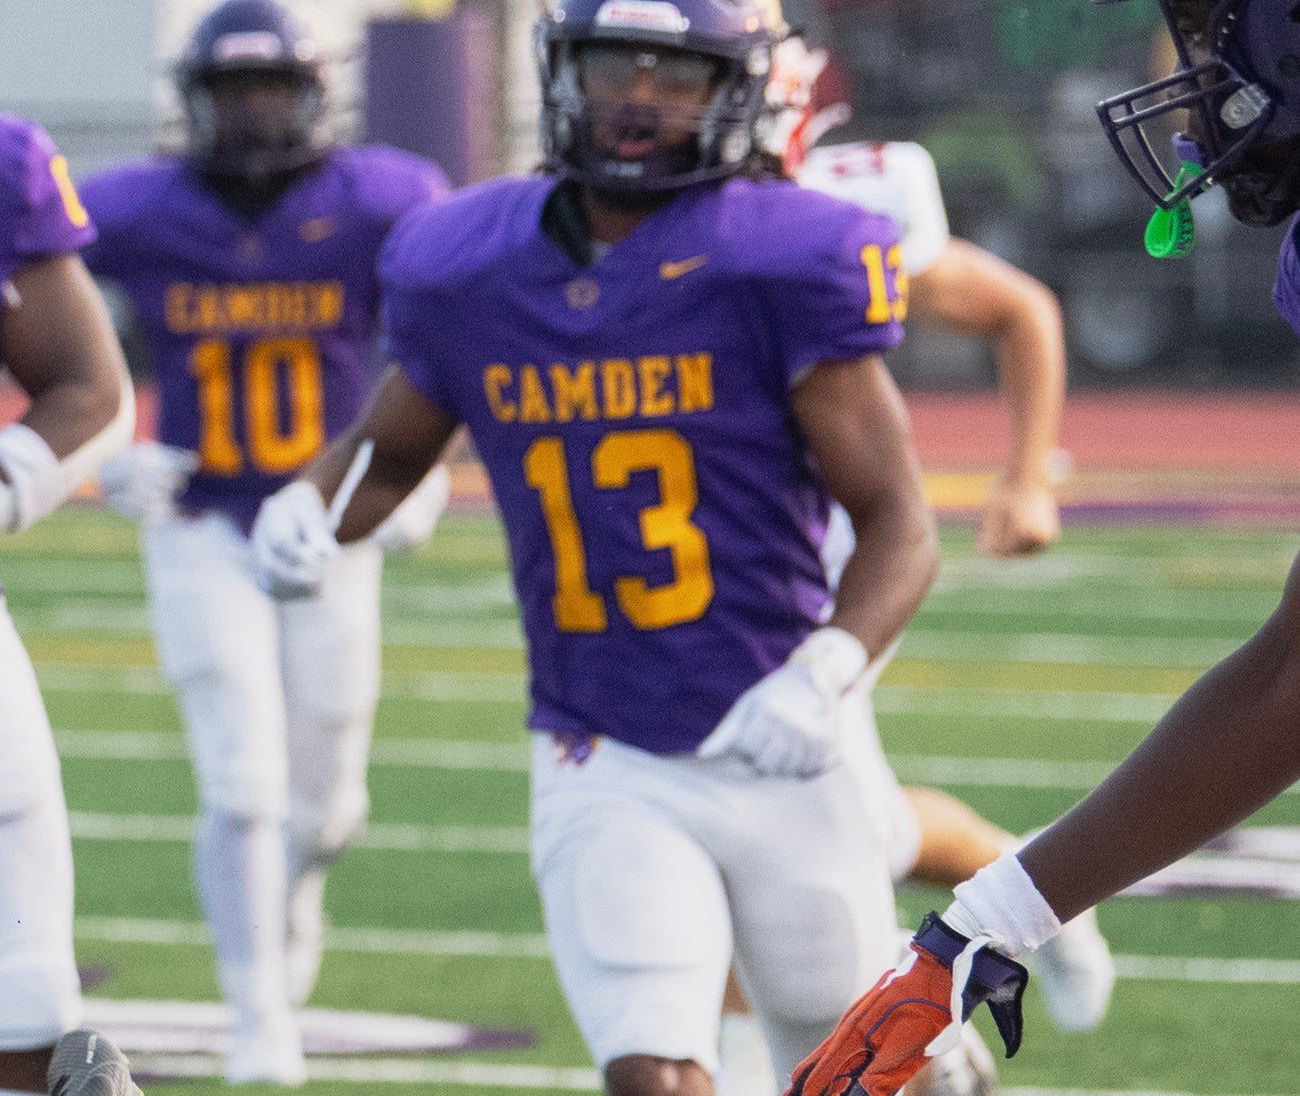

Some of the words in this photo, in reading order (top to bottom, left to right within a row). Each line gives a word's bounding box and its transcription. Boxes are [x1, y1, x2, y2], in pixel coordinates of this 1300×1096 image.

[187, 336, 324, 478] 10
[483, 352, 714, 424] CAMDEN
[523, 428, 715, 633] 13
